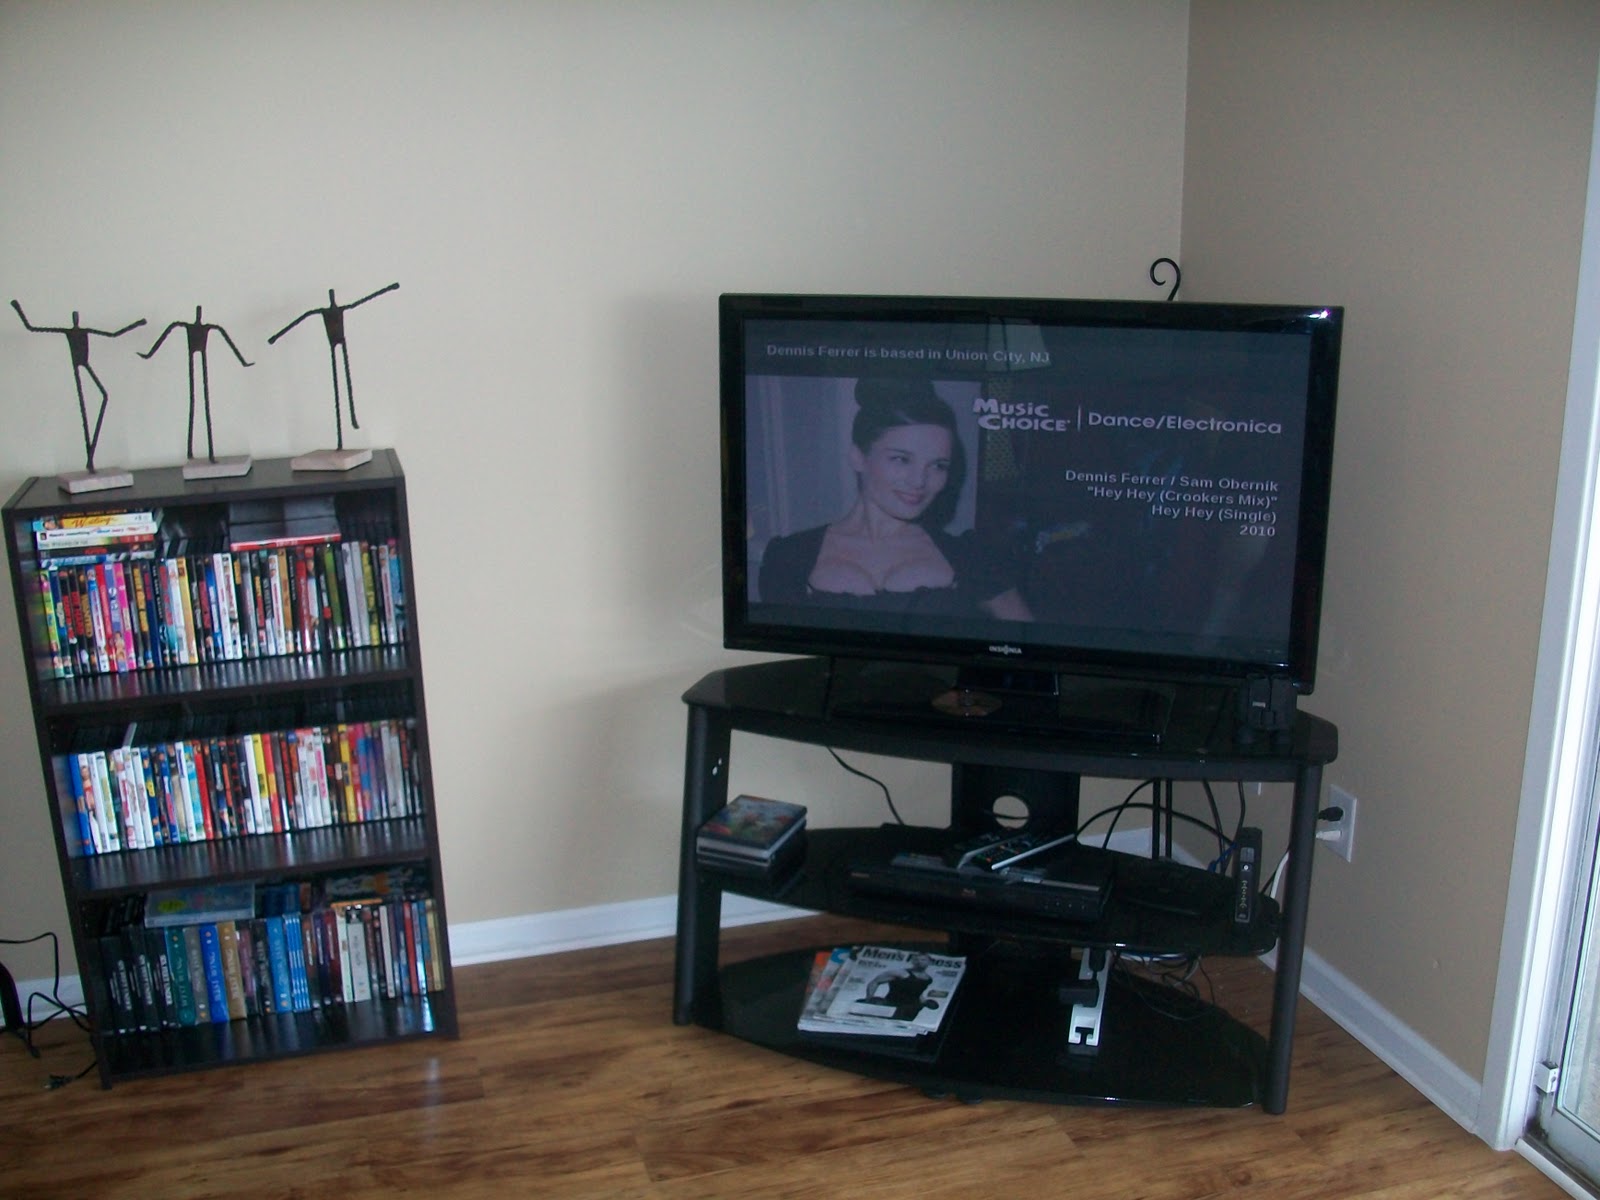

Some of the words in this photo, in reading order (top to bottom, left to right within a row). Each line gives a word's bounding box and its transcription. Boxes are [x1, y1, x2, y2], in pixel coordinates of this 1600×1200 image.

[766, 344, 816, 357] Dennis
[818, 346, 861, 358] Ferrer
[863, 347, 878, 358] is
[880, 347, 924, 360] based
[928, 348, 942, 360] in
[945, 349, 989, 361] Union
[992, 350, 1026, 364] City,
[1029, 351, 1051, 363] NJ
[977, 413, 1068, 432] CHOICE
[1087, 411, 1282, 434] Dance/Electronica
[1065, 469, 1117, 484] Dennis
[1120, 472, 1167, 486] Ferrer
[1179, 475, 1214, 489] Sam
[1218, 478, 1279, 492] Obernik
[1125, 488, 1156, 504] Hey
[1159, 489, 1235, 505] (Crookers
[1151, 504, 1181, 520] Hey
[1184, 506, 1214, 521] Hey
[1217, 508, 1277, 525] (Single)
[1239, 525, 1277, 538] 2010
